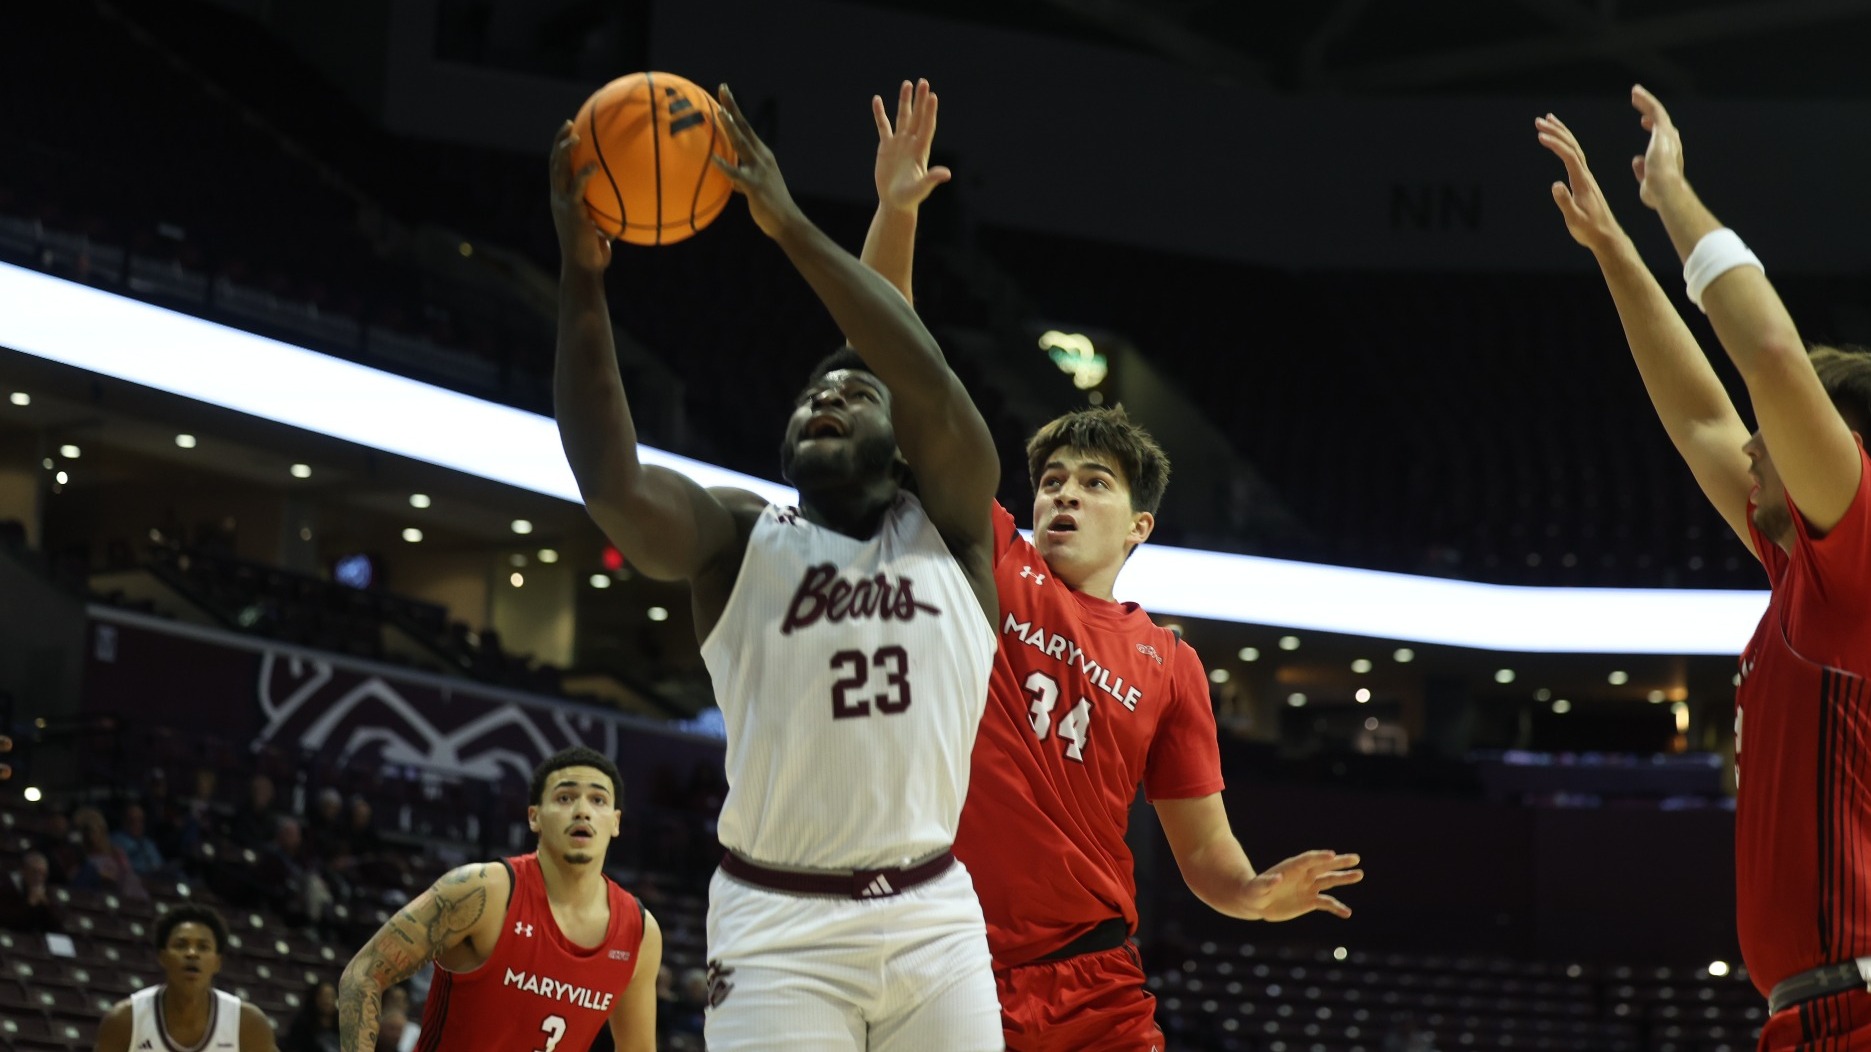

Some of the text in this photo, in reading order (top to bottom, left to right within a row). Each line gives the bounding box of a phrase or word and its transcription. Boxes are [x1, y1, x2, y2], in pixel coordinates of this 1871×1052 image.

[1391, 183, 1481, 229] NN
[781, 563, 942, 634] Bears
[830, 645, 912, 719] 23
[1003, 612, 1143, 712] MARYVILLE
[1023, 670, 1094, 763] 34
[503, 967, 614, 1011] MARYVILLE
